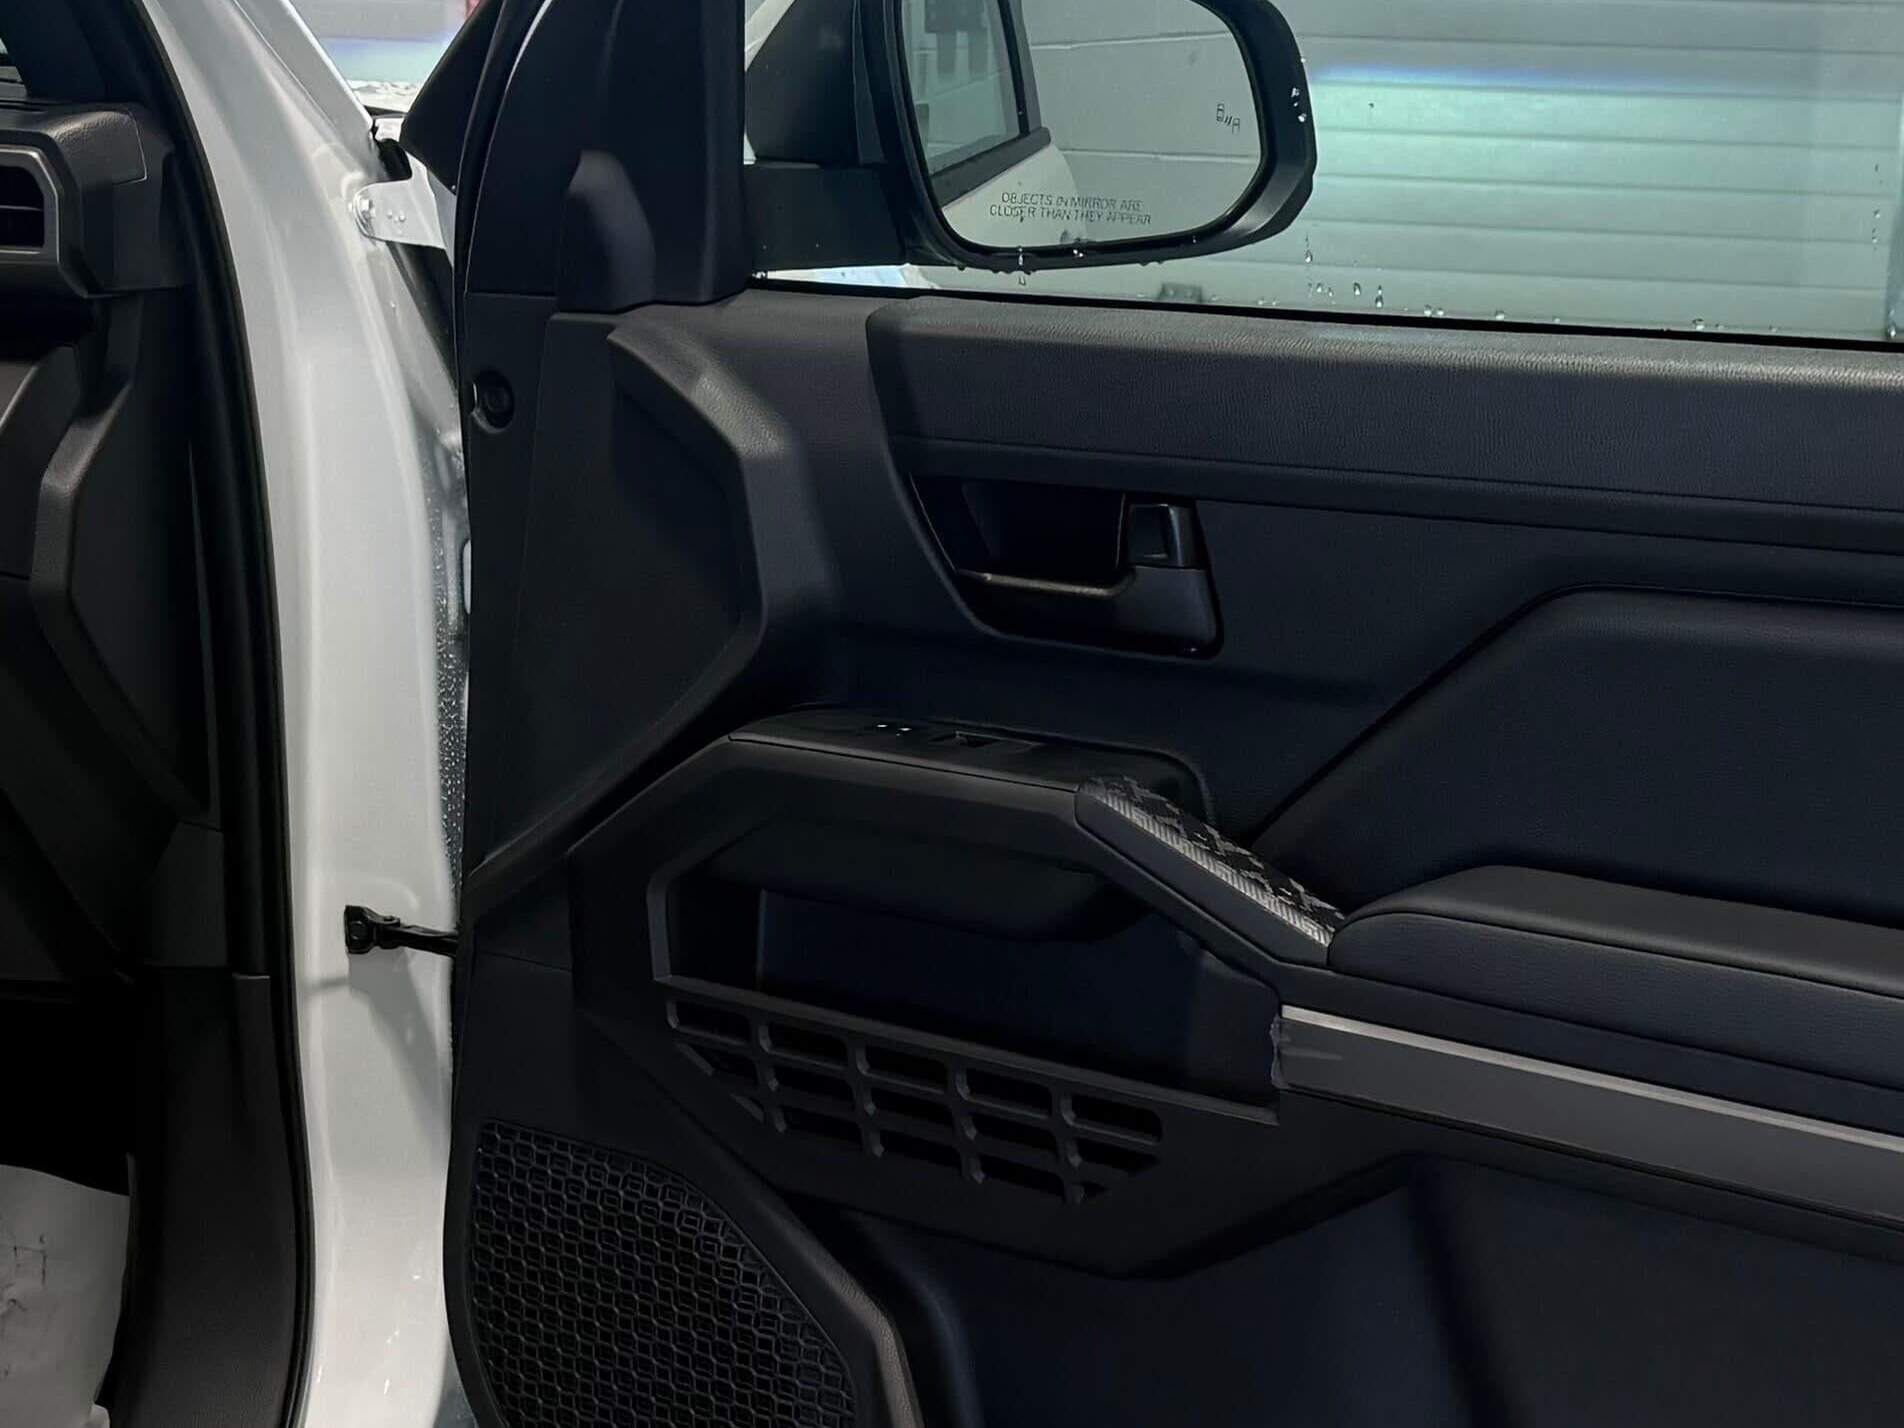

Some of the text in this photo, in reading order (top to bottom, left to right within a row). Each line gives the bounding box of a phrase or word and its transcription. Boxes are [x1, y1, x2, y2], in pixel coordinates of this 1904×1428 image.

[1001, 191, 1052, 206] OBJECTS
[1069, 196, 1117, 210] MIRROR
[1119, 199, 1142, 212] ARE
[989, 204, 1152, 225] CLOSER THAN THEY APPEAR
